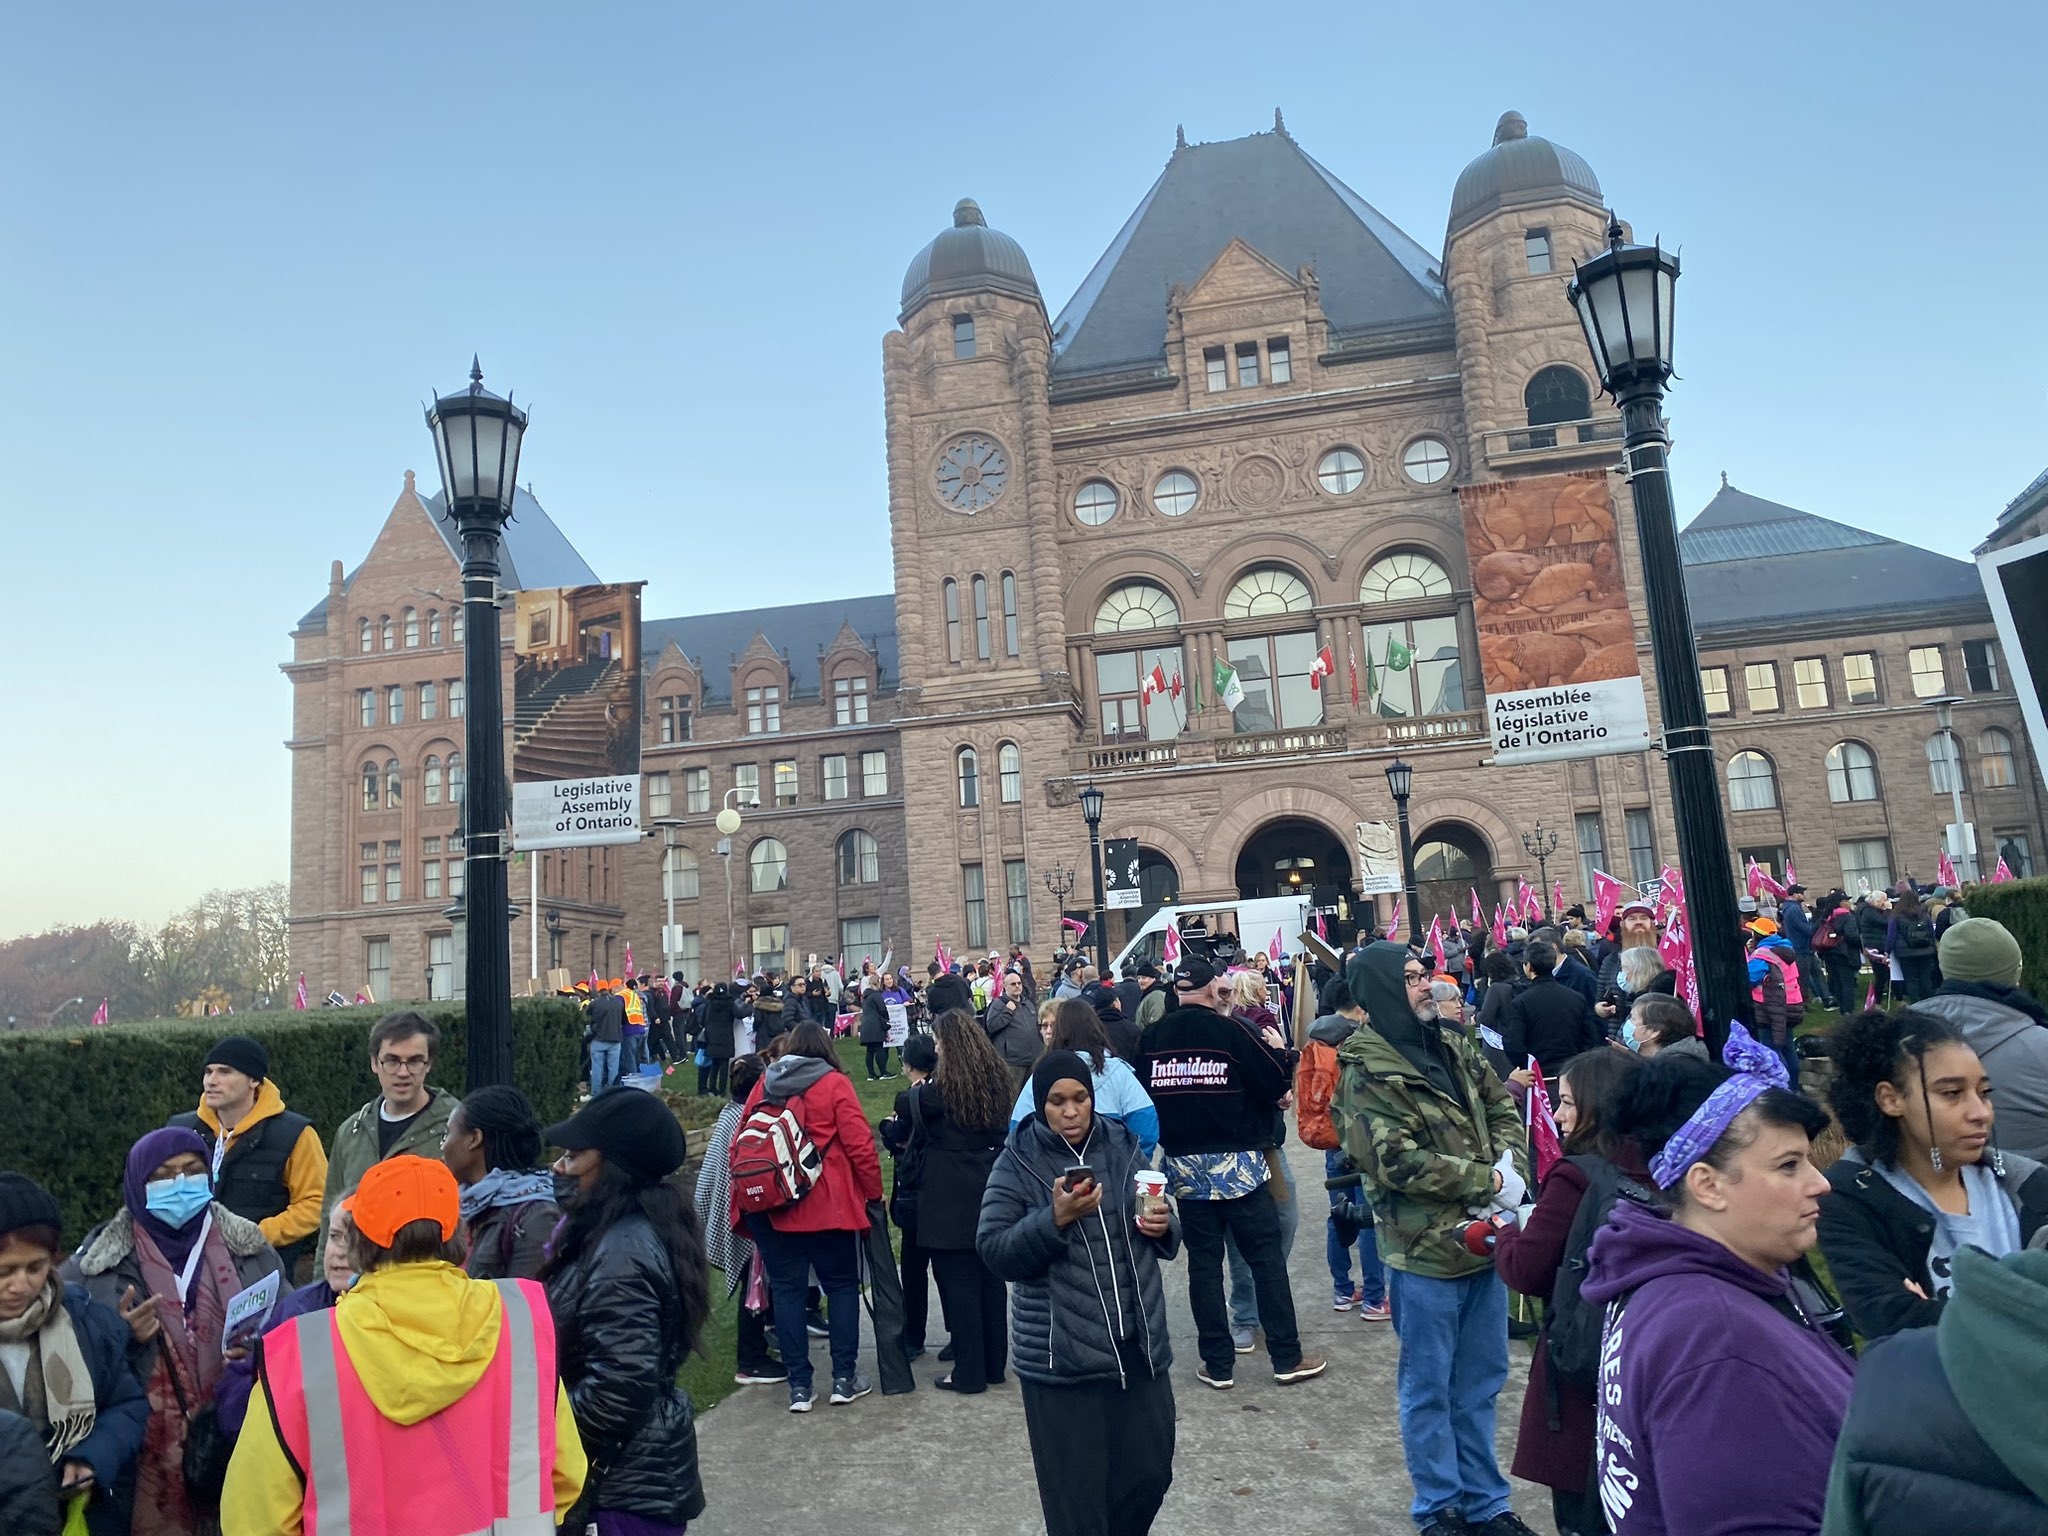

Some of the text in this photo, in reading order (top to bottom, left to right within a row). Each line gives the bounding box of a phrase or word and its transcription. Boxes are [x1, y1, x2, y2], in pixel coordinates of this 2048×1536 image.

[1494, 688, 1592, 713] Assemblée
[1496, 709, 1589, 733] législative
[1499, 735, 1521, 749] de
[554, 780, 632, 800] Legislative
[561, 796, 632, 814] Assembly
[556, 814, 632, 831] of Ontario
[1150, 1056, 1228, 1078] Intimidator
[1150, 1077, 1193, 1088] FOREVER
[1203, 1076, 1228, 1085] MAN
[746, 1185, 764, 1196] ROOTS
[230, 1289, 267, 1320] spring
